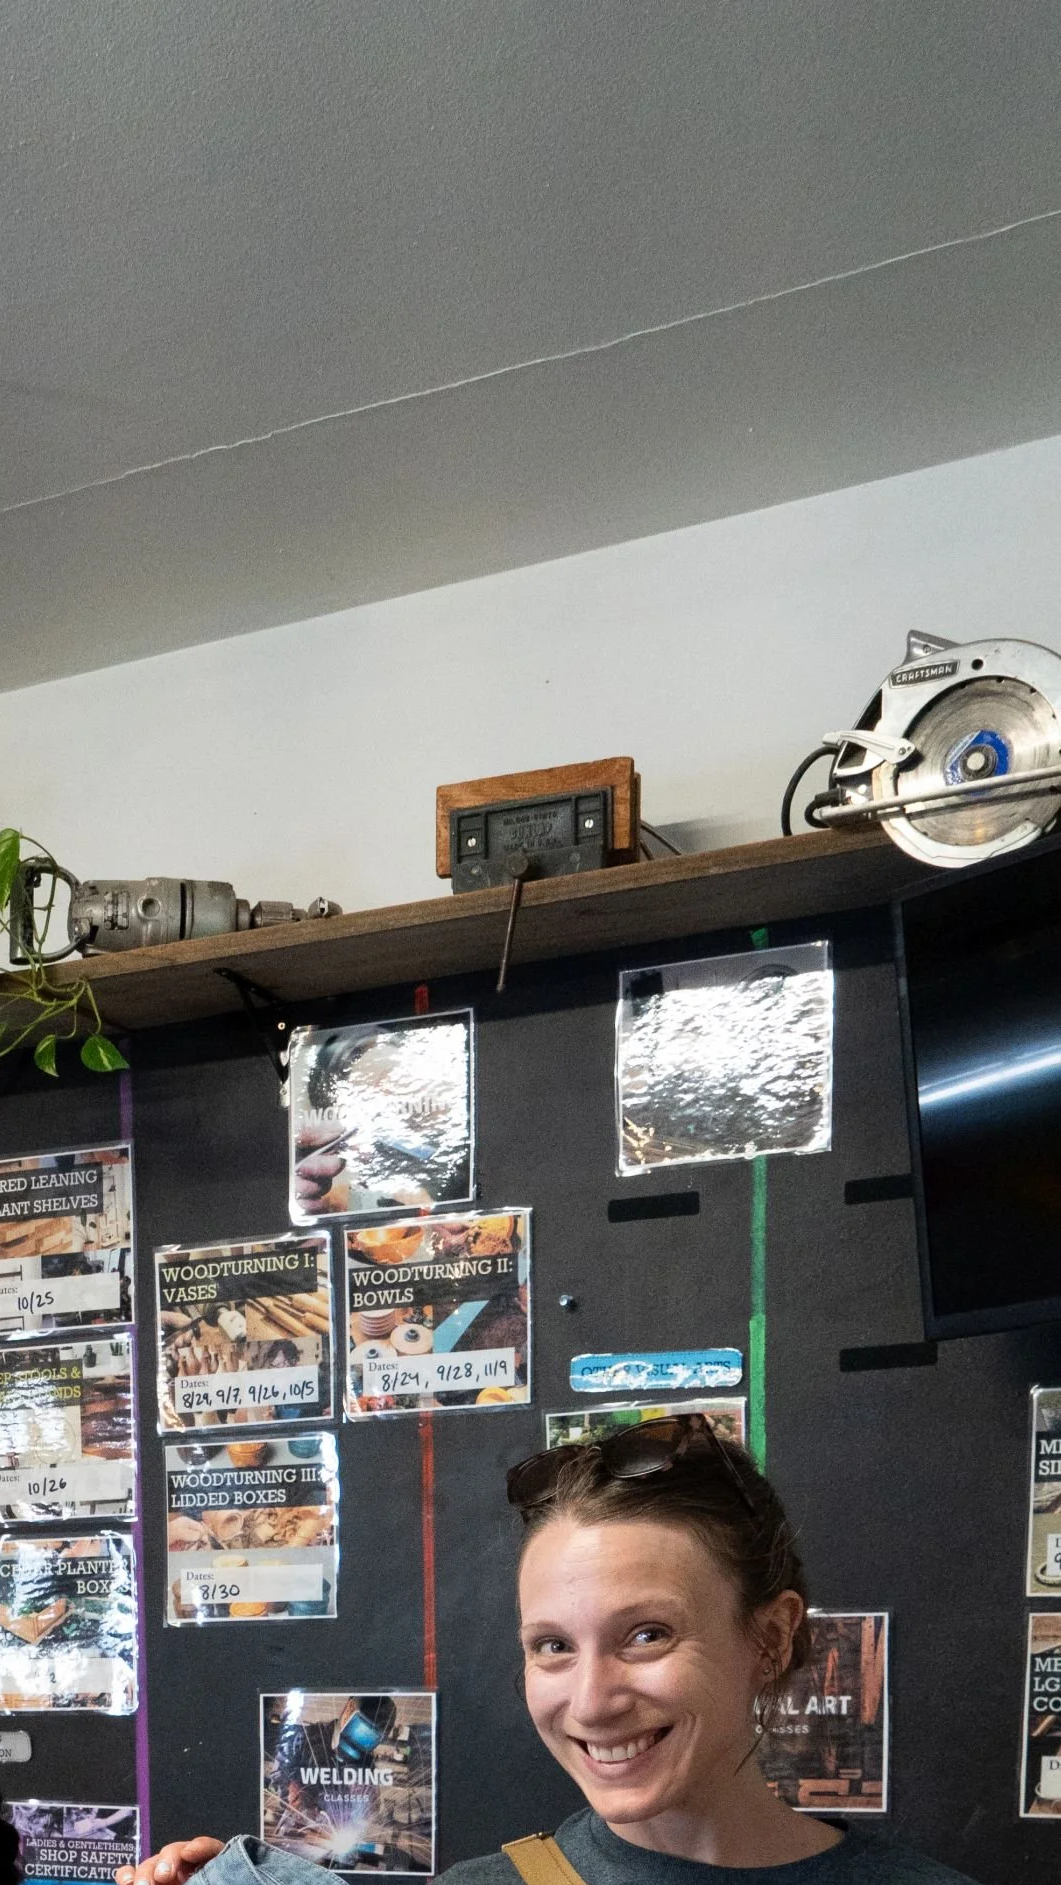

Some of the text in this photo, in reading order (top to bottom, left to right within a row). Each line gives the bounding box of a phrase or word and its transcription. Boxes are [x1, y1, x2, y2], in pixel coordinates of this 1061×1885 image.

[895, 665, 953, 683] CRAFTSMAN
[30, 1170, 98, 1190] LEANING
[33, 1194, 99, 1213] SHELVES
[162, 1253, 315, 1283] WOODTURNING I:
[352, 1258, 514, 1287] WOODTURNING II:
[17, 1291, 55, 1315] 10/25
[163, 1284, 218, 1304] VASES
[353, 1288, 414, 1307] BOWLS
[70, 1366, 81, 1379] &
[368, 1362, 399, 1372] Dates:
[484, 1360, 508, 1376] 11/9
[180, 1378, 209, 1389] Dates:
[289, 1380, 315, 1398] 10/5
[27, 1477, 68, 1496] 10/26
[170, 1468, 297, 1489] WOODTURNING
[170, 1488, 287, 1509] LIDDED BOXES
[186, 1571, 214, 1581] Dates:
[198, 1584, 241, 1600] 8/30
[805, 1695, 852, 1715] ART
[755, 1724, 810, 1734] CSSES
[300, 1767, 394, 1786] WELDING
[323, 1793, 370, 1802] CLASSES
[26, 1838, 57, 1848] LADIES
[58, 1840, 66, 1849] &
[39, 1848, 134, 1865] SHOP SAFETY
[24, 1863, 118, 1880] CERTIFICATIO
